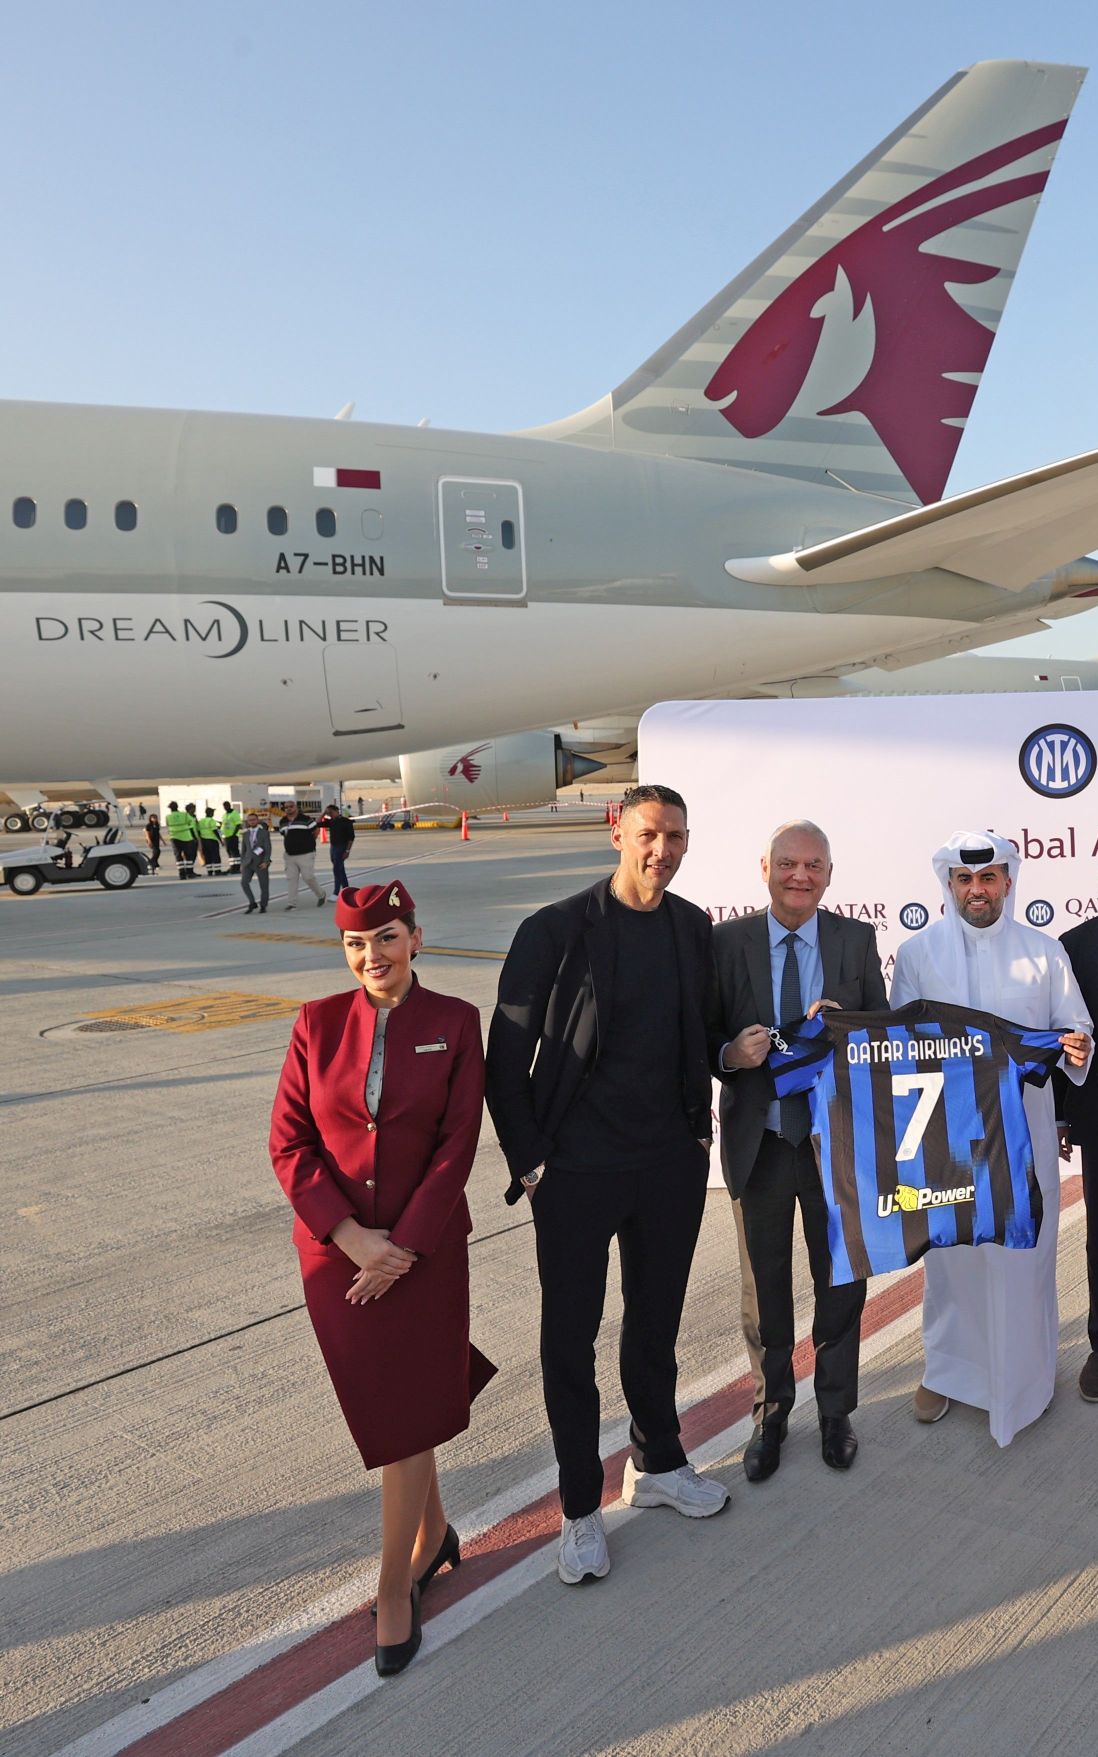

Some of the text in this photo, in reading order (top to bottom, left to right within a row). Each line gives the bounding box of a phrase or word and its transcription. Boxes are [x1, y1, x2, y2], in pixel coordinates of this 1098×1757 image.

[275, 552, 385, 577] A7-BHN
[817, 902, 888, 920] ATAR
[846, 1034, 985, 1065] QATAR AIRWAYS
[891, 1071, 944, 1162] 7
